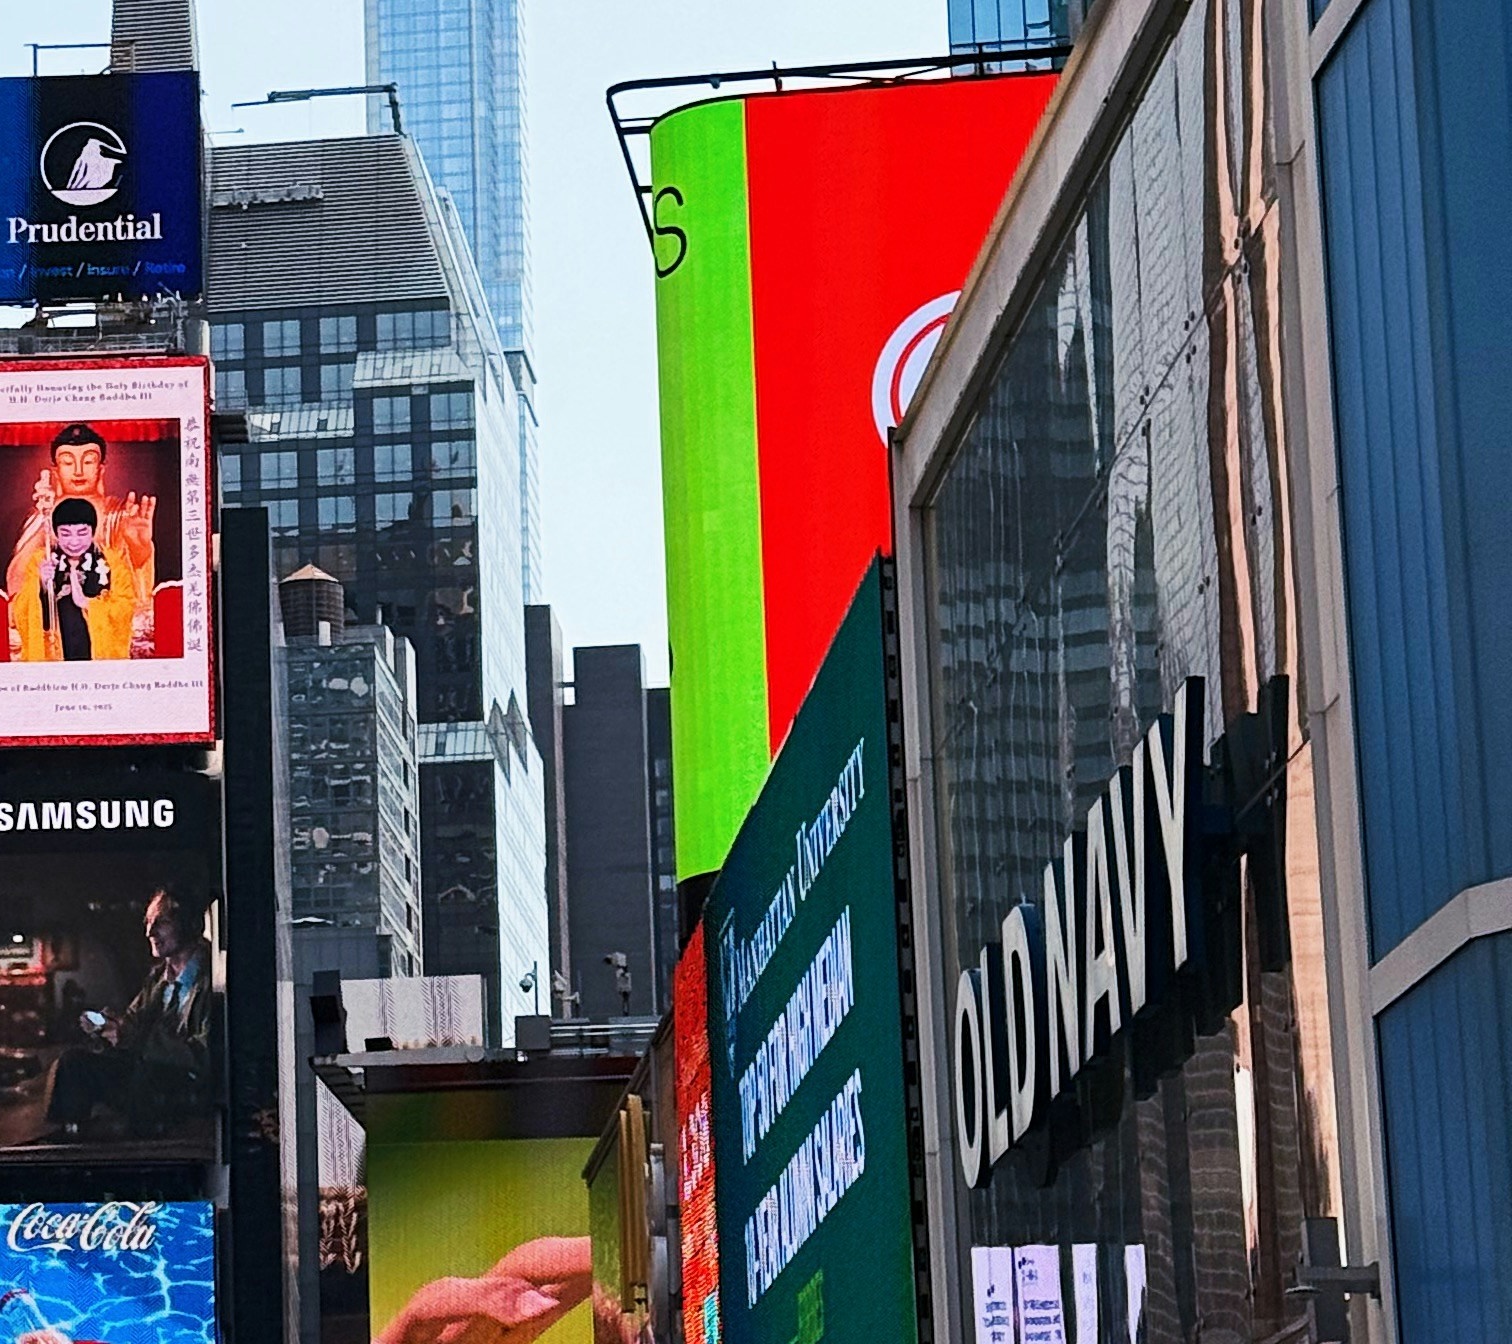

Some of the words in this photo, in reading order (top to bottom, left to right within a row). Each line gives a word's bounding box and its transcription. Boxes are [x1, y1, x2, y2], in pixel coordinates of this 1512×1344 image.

[7, 213, 162, 244] Prudential
[736, 865, 795, 1013] MANHATTAN
[796, 737, 864, 901] UNIVERSITY
[955, 905, 1035, 1189] OLD
[1044, 680, 1187, 1100] NAVY
